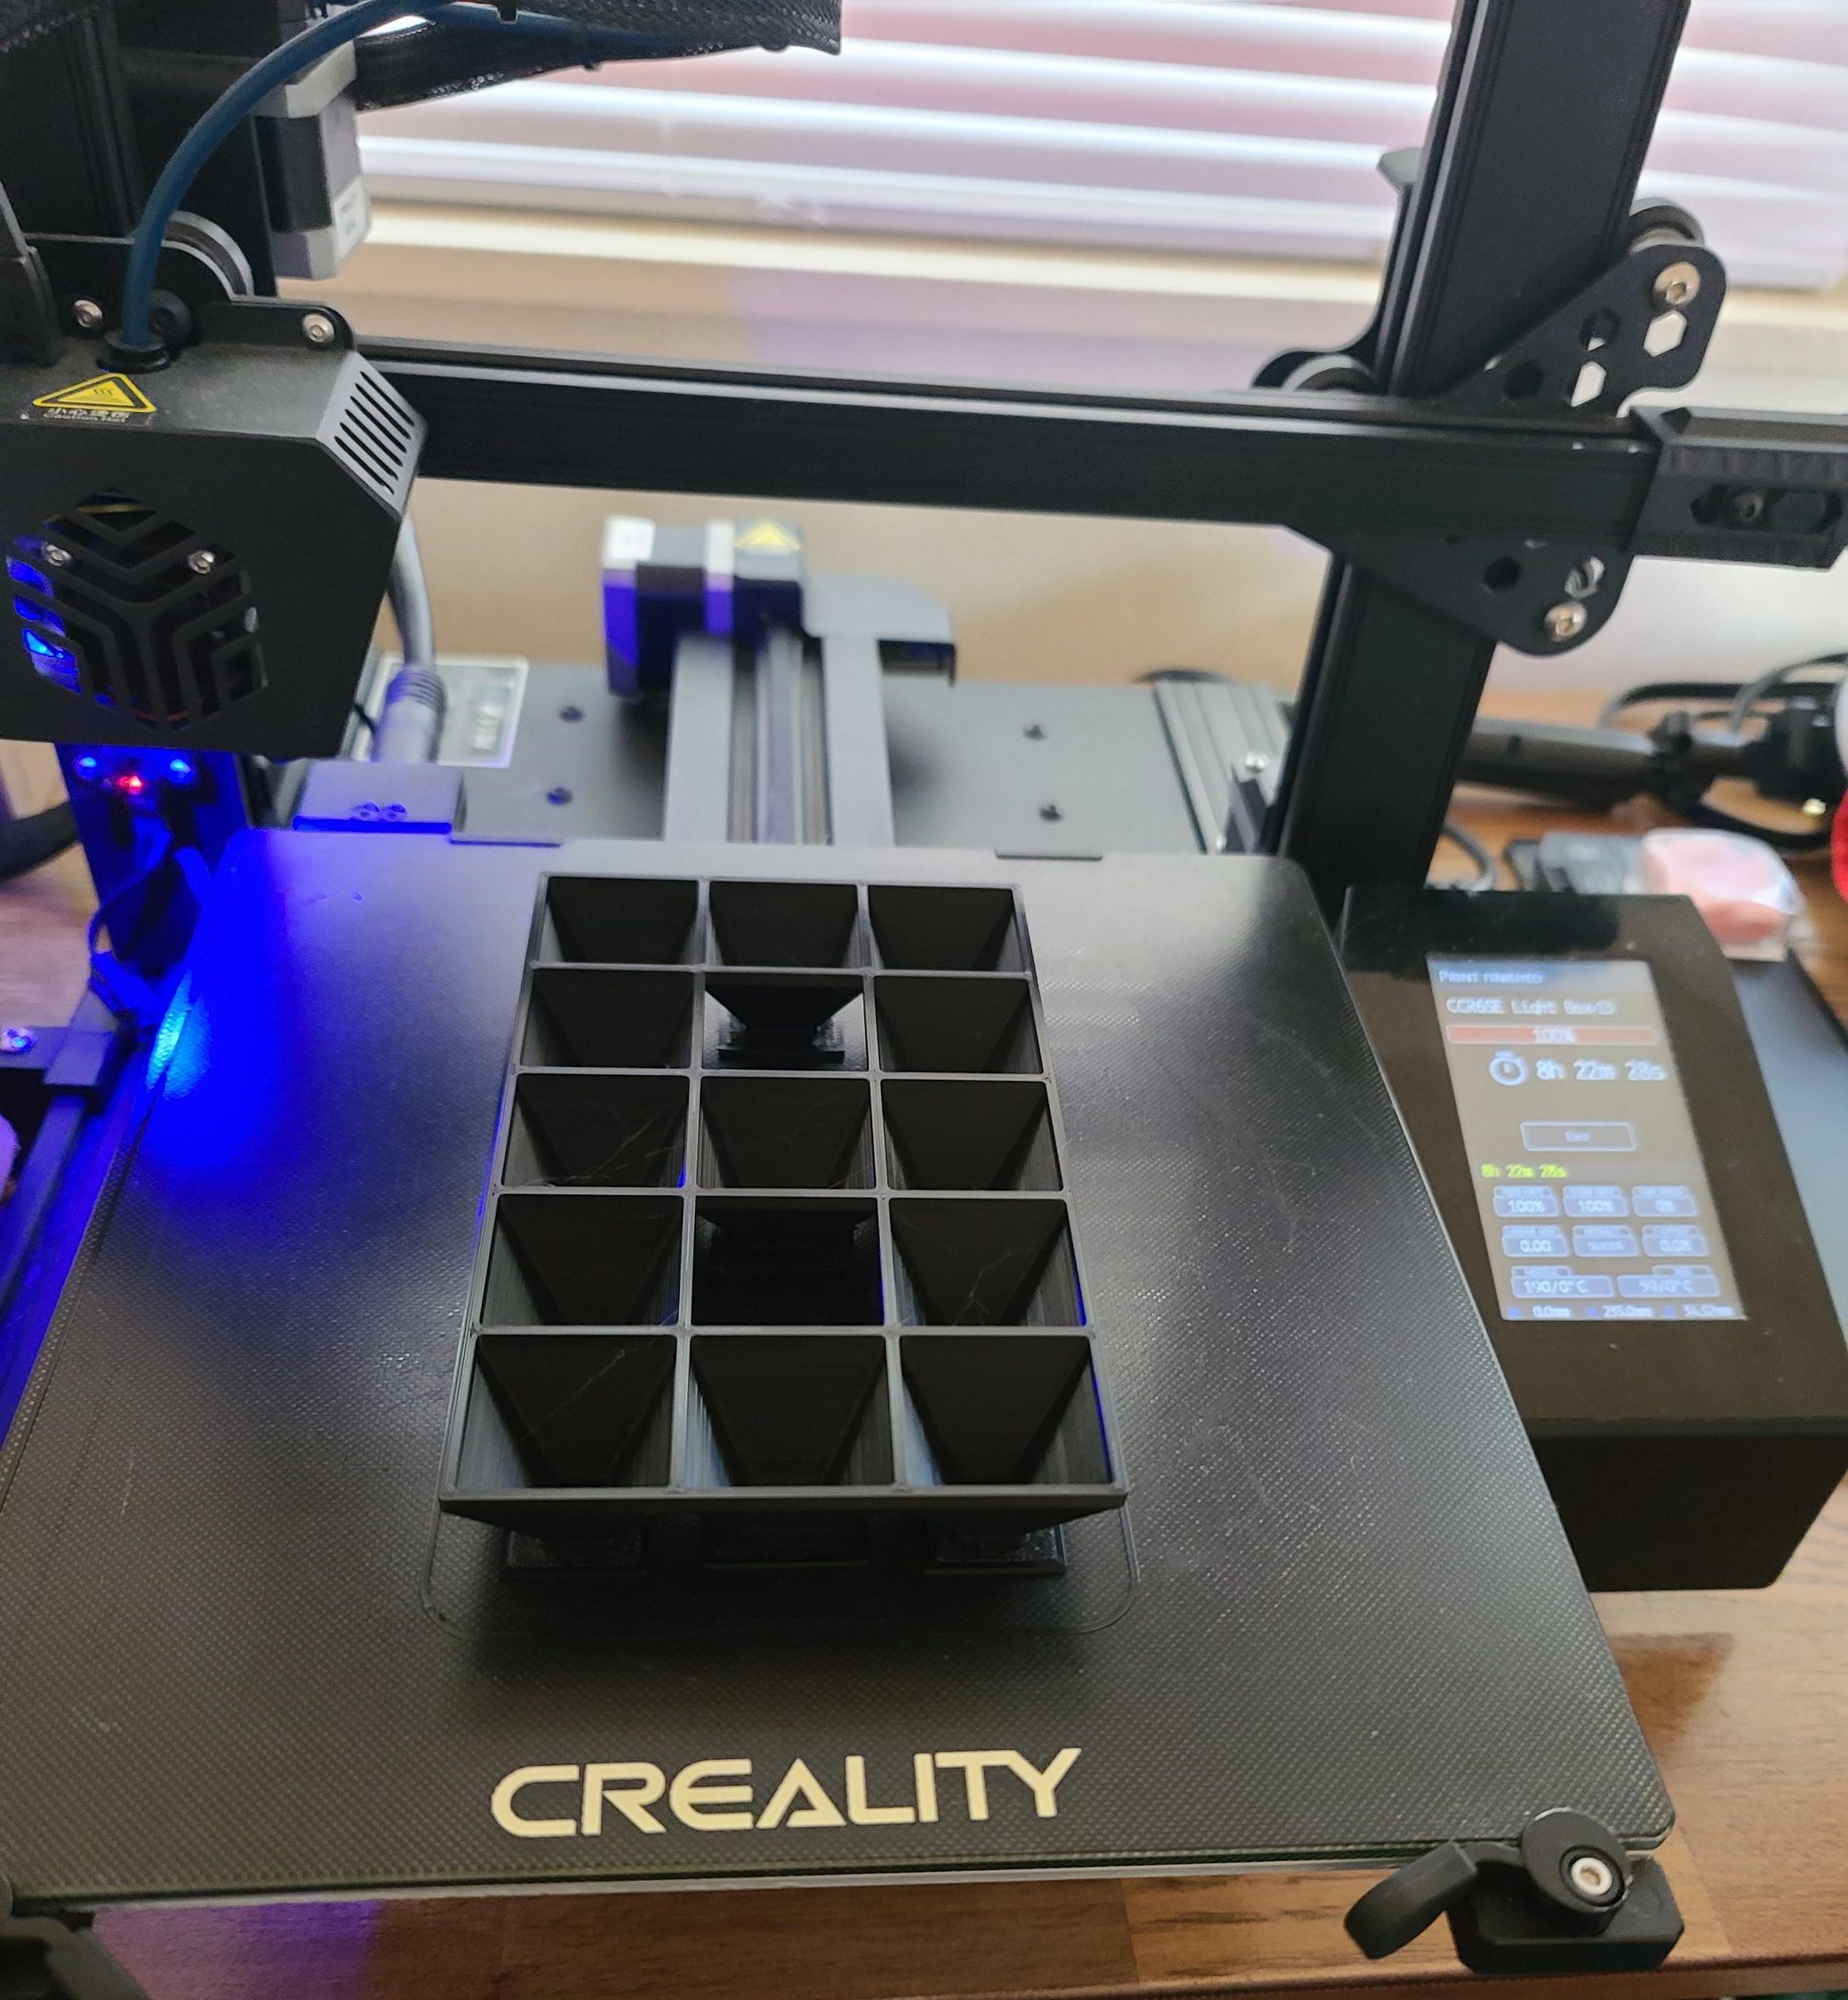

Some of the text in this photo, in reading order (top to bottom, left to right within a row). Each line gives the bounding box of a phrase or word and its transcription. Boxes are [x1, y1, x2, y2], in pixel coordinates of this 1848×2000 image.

[1533, 1027, 1576, 1042] 100%
[1536, 1059, 1666, 1080] 8h 22m 28s
[1506, 1164, 1535, 1178] 22m
[1508, 1200, 1545, 1212] 100%
[1578, 1200, 1615, 1212] 100%
[1656, 1200, 1676, 1212] 0%
[1520, 1239, 1551, 1252] 0.00
[491, 1747, 1082, 1838] CREALITY
